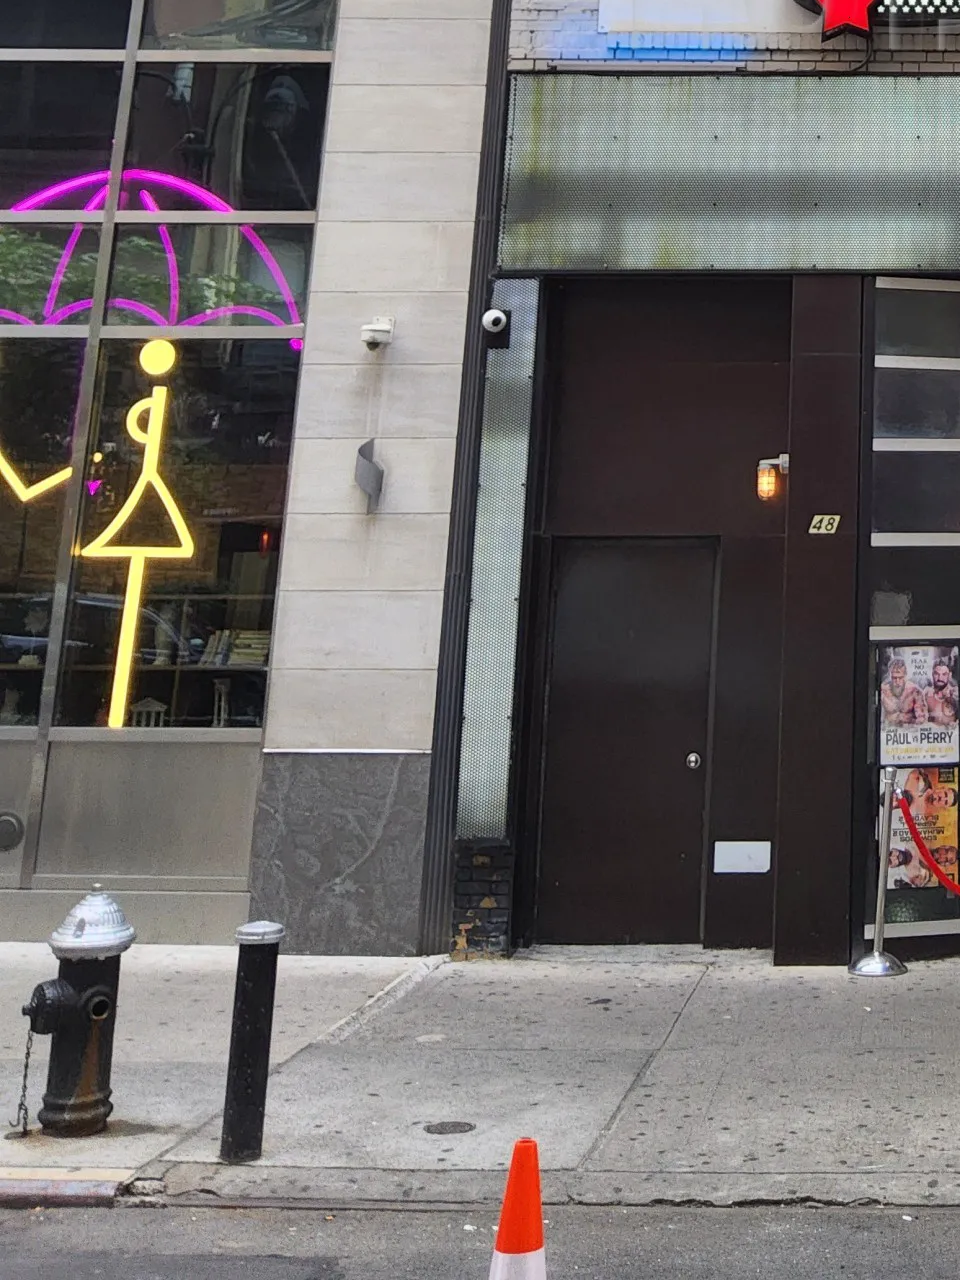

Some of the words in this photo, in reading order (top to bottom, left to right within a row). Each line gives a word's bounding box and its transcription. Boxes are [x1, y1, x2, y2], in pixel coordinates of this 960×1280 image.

[811, 516, 836, 532] 48
[885, 733, 912, 746] PAUL
[919, 731, 954, 744] PERRY
